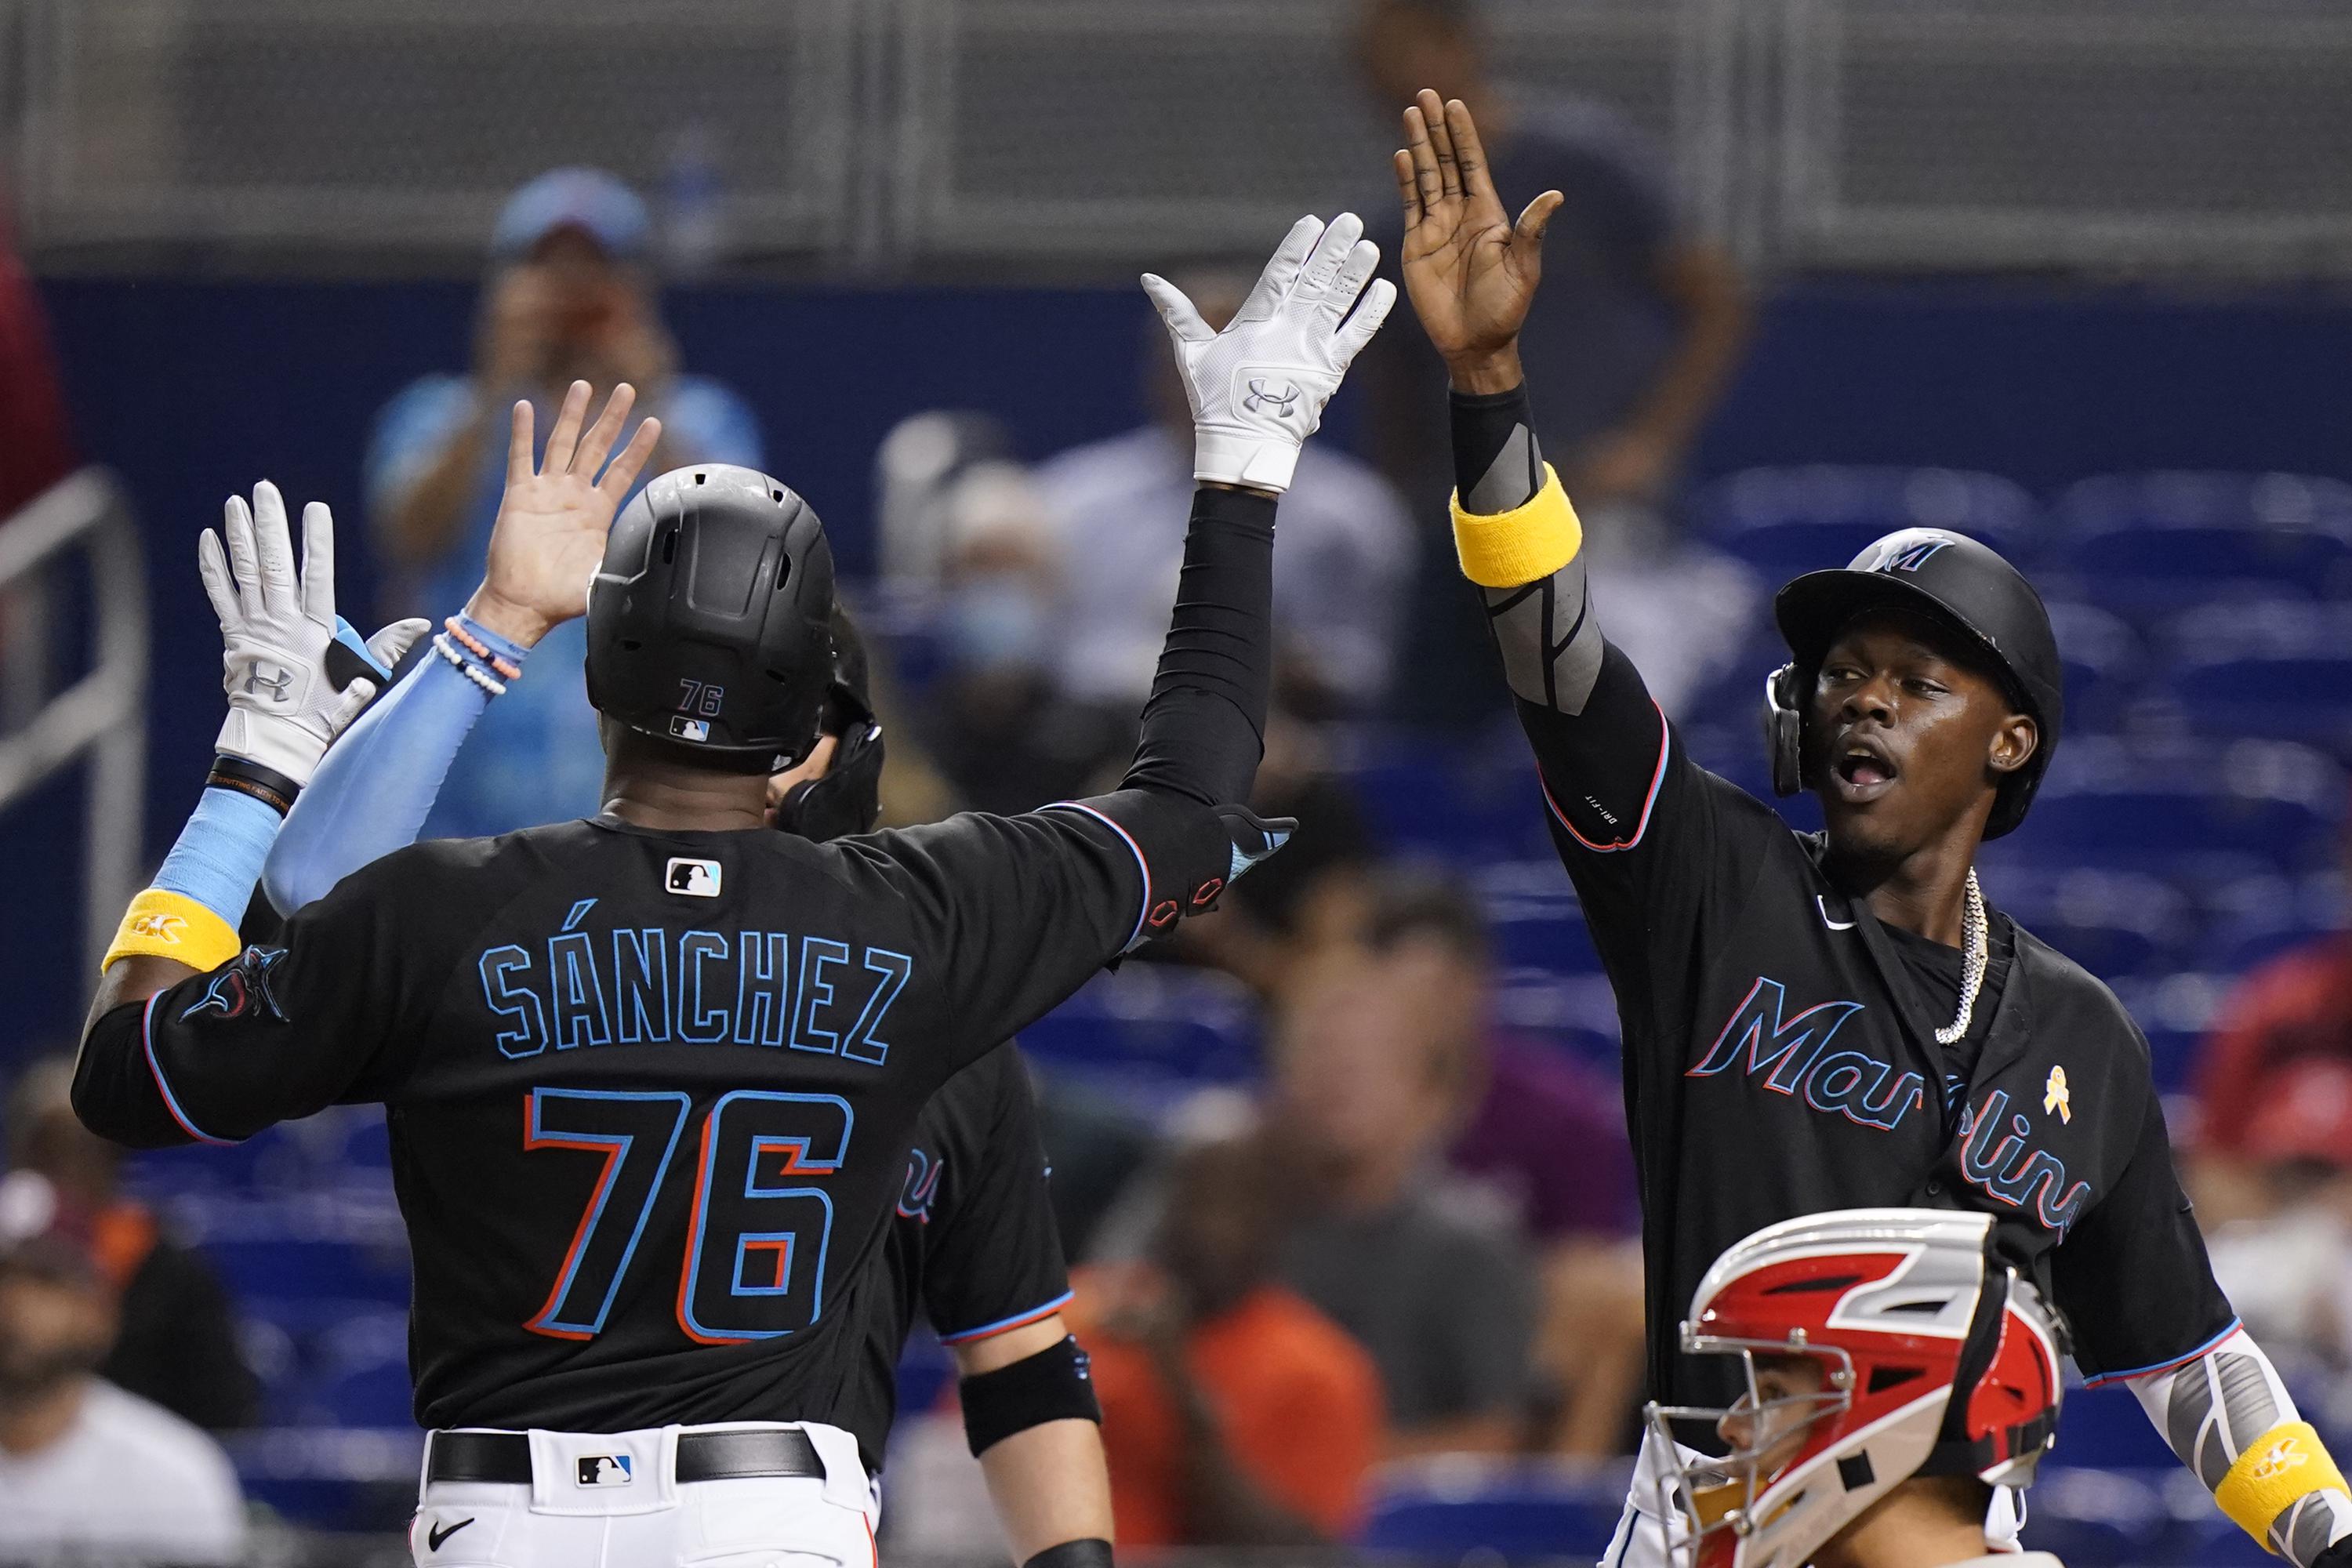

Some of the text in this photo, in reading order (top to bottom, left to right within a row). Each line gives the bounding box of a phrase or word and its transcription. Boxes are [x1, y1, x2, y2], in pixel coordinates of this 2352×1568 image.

[677, 678, 724, 717] 76
[1584, 794, 1617, 825] DRI-FIT
[477, 898, 913, 1066] SÁNCHEZ
[1684, 976, 2092, 1247] Marlin
[521, 1085, 855, 1345] 76
